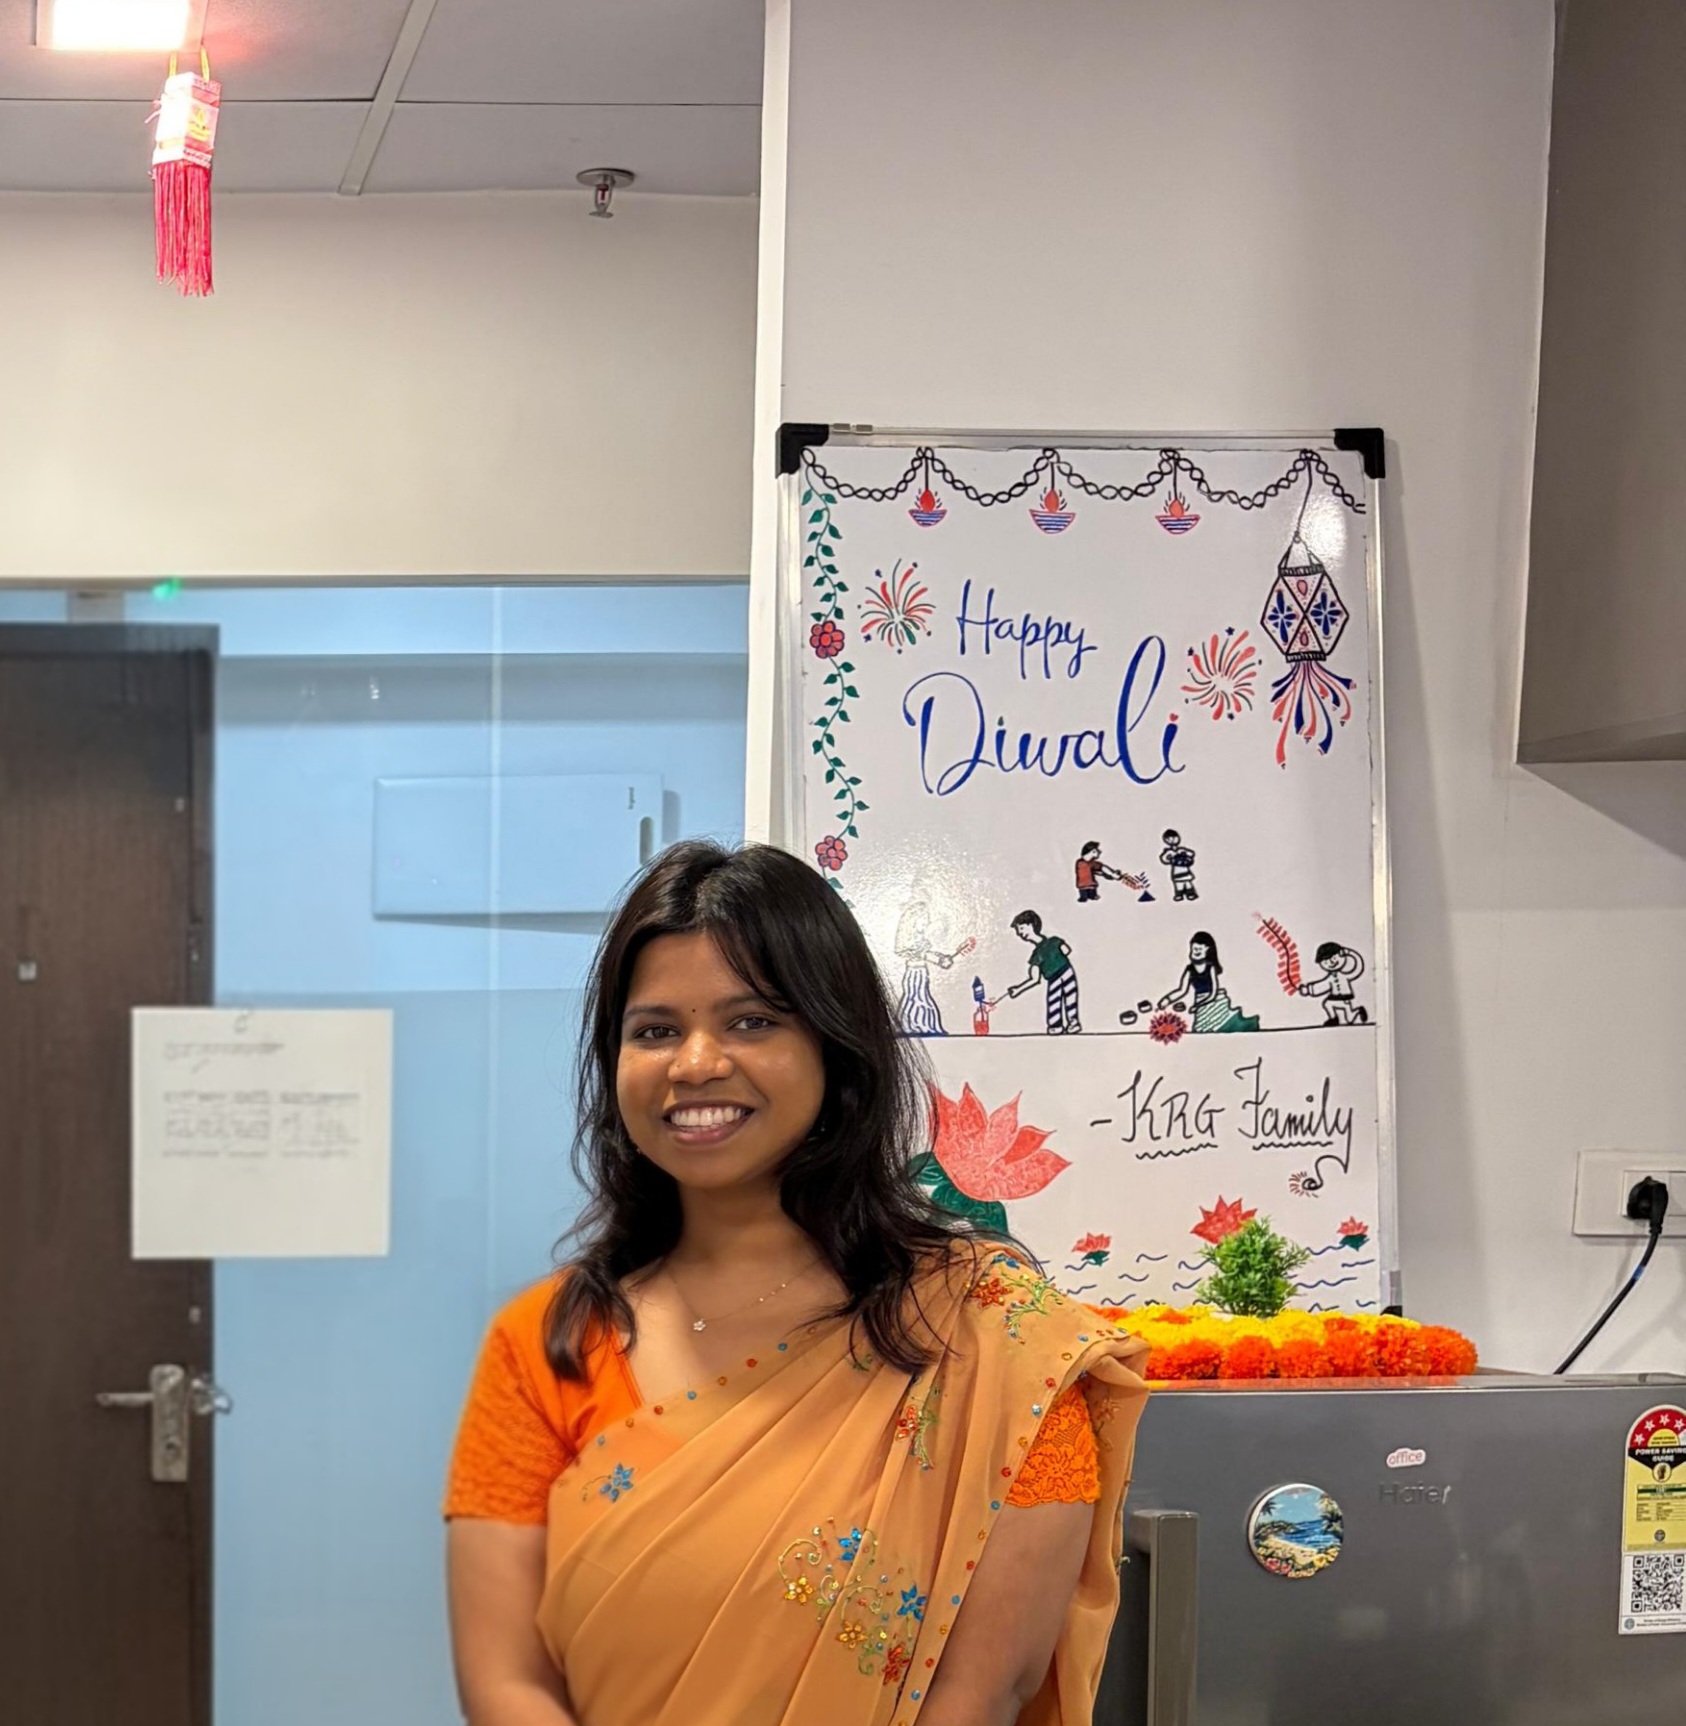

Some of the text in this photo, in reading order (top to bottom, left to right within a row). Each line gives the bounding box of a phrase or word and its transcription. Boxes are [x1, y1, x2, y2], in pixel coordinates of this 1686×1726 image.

[956, 579, 1098, 680] Happy
[902, 635, 1186, 796] Diwali
[1233, 1056, 1353, 1174] Family
[1388, 1451, 1423, 1465] office
